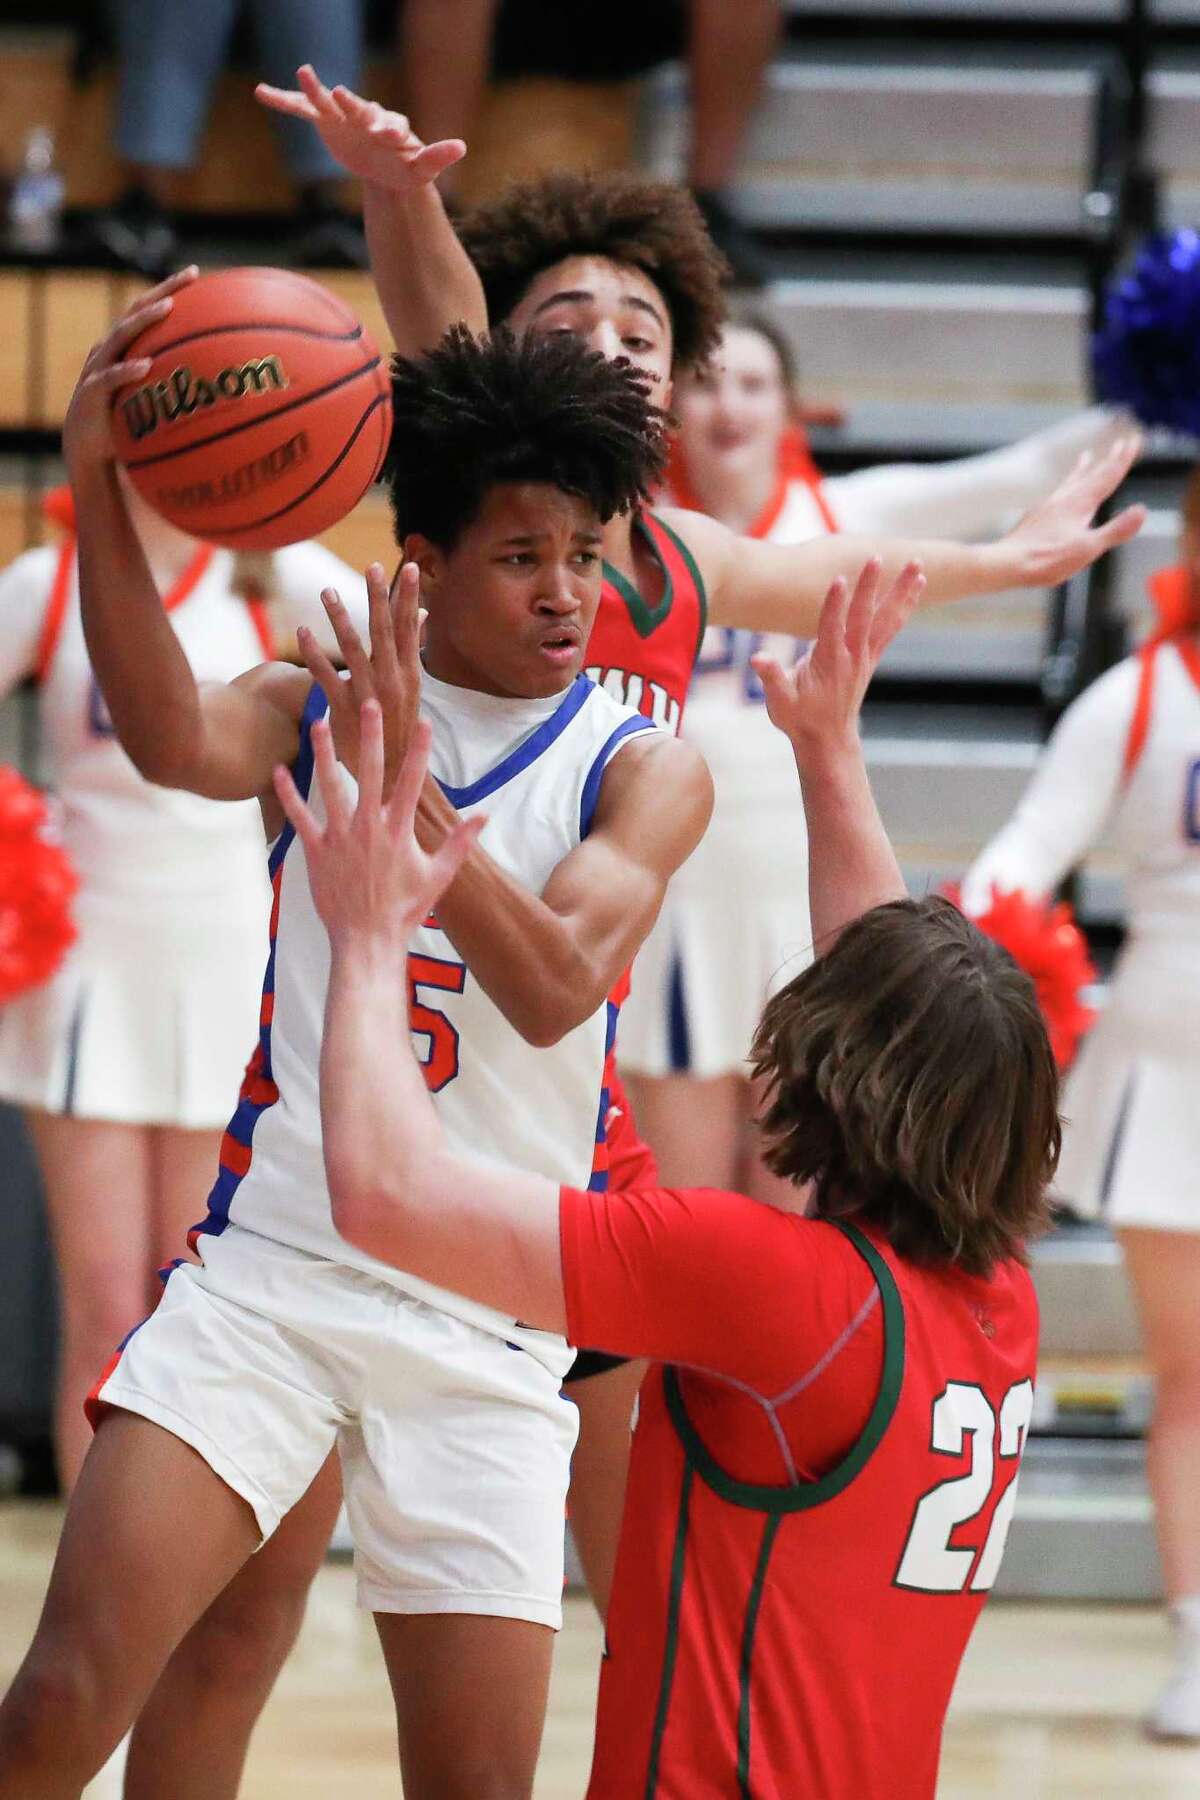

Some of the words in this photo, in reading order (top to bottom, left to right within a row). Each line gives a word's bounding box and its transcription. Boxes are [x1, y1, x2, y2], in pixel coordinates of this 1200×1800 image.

[122, 354, 290, 440] Wilson
[405, 951, 467, 1094] 5
[891, 1377, 1036, 1594] 22
